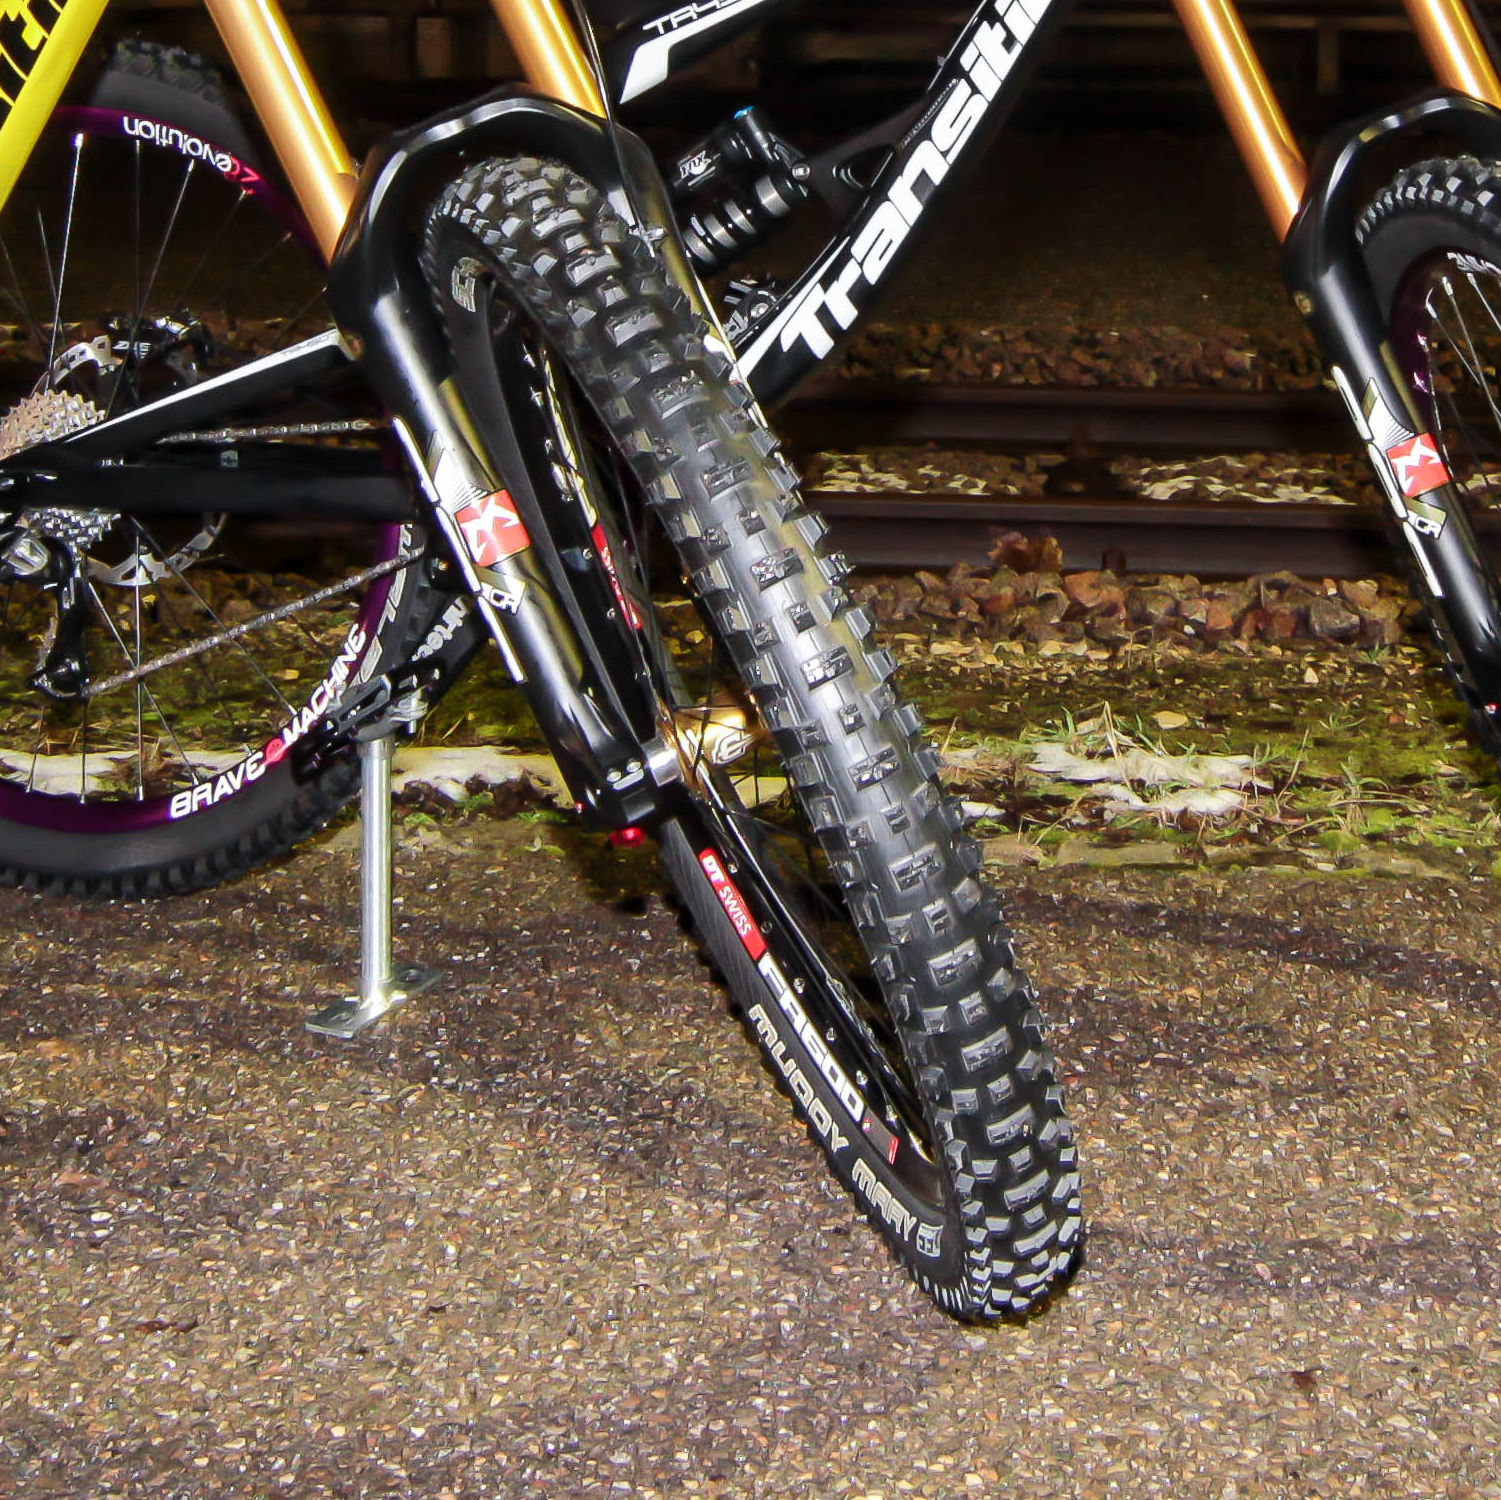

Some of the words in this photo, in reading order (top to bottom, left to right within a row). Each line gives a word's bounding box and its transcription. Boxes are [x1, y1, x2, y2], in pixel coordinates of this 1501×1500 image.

[122, 115, 234, 174] evolution
[169, 750, 268, 820] BRAVE
[281, 622, 367, 747] MACHINE
[702, 854, 726, 884] DT
[718, 884, 752, 938] SWISS
[748, 1003, 852, 1155] MUDDY
[851, 1157, 918, 1242] MARY
[757, 950, 866, 1124] FR600
